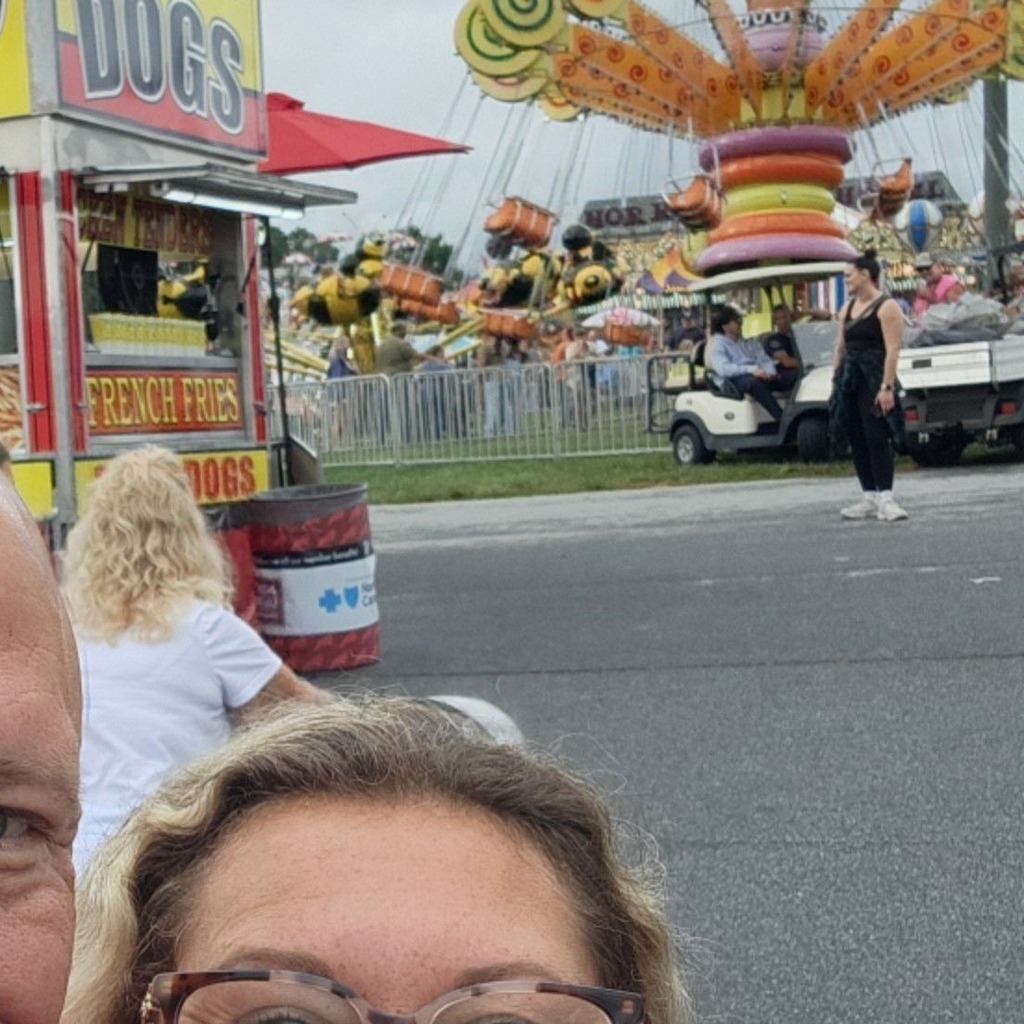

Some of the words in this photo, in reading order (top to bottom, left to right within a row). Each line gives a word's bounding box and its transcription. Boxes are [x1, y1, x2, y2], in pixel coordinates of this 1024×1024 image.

[77, 0, 245, 135] DOGS
[86, 377, 178, 427] FRENCH
[180, 377, 239, 423] FRIES
